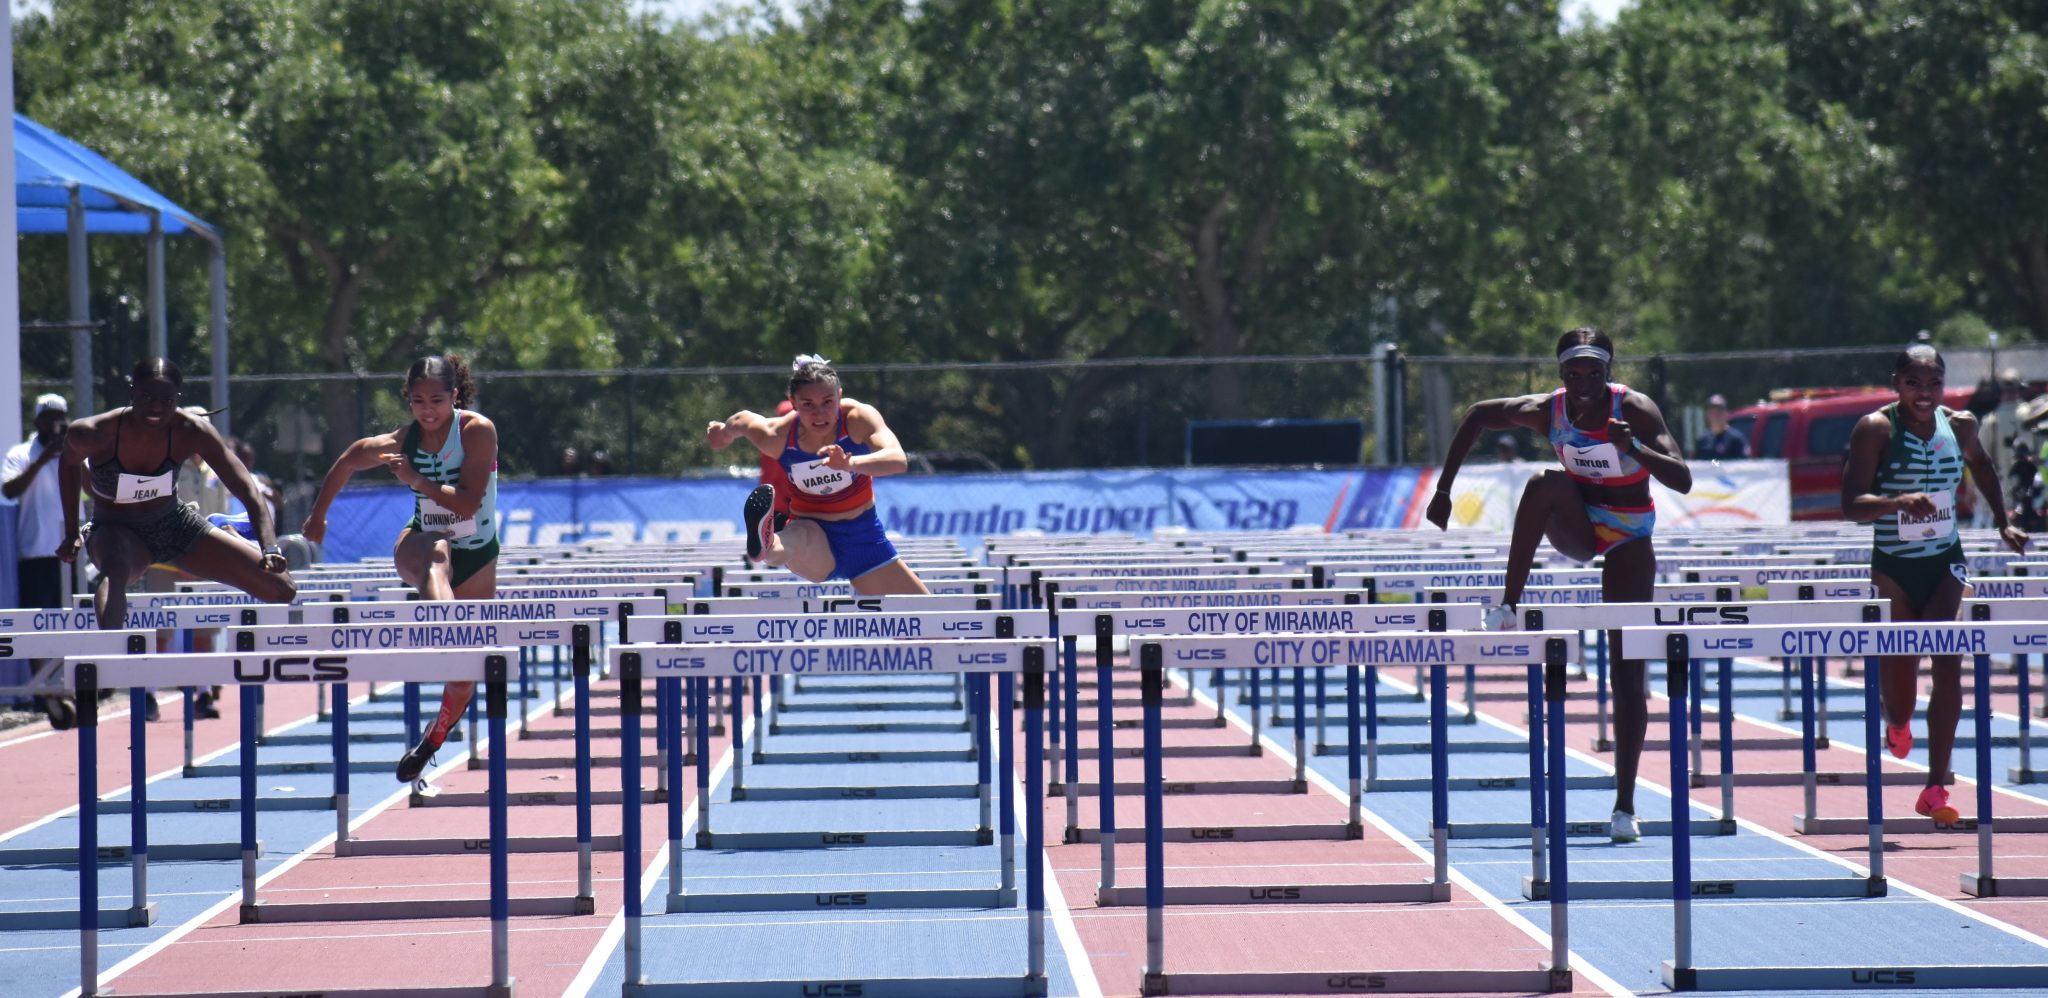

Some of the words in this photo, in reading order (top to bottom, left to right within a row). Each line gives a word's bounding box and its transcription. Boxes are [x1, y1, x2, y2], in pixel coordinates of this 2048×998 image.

[1573, 458, 1610, 468] TAYLOR
[802, 472, 843, 488] VARGAS
[132, 488, 159, 499] JEAN
[886, 504, 1024, 536] Mondo
[1035, 501, 1159, 534] Super
[1431, 575, 1462, 587] CITY
[1466, 575, 1484, 586] OF
[1488, 574, 1554, 586] MIMAR
[1569, 577, 1600, 585] UCS
[1814, 570, 1872, 580] MIRAMA
[1551, 590, 1572, 604] OF
[1670, 593, 1705, 601] UCS
[1825, 588, 1860, 597] UCS
[803, 599, 882, 612] UCS
[1141, 595, 1176, 608] CITY
[1181, 595, 1202, 608] OF
[1207, 594, 1281, 608] MIRAMAR
[360, 610, 395, 619] UCS
[414, 605, 450, 622] CITY
[455, 604, 475, 621] OF
[481, 603, 556, 620] MIRAMAR
[574, 607, 609, 616] UCS
[1655, 606, 1749, 625] UCS
[34, 612, 70, 631] CITY
[75, 612, 95, 630] OF
[123, 611, 177, 628] RAMAR
[196, 614, 230, 623] UCS
[1124, 618, 1166, 628] UCS
[1188, 612, 1229, 632] CITY
[1235, 612, 1259, 631] OF
[1265, 610, 1353, 631] MIRAMAR
[1375, 615, 1415, 624] UCS
[694, 625, 734, 635] UCS
[757, 619, 798, 640] CITY
[804, 618, 828, 639] OF
[834, 617, 921, 638] MIRAMAR
[942, 621, 983, 631] UCS
[267, 635, 308, 645] UCS
[332, 628, 373, 649] CITY
[379, 627, 403, 647] OF
[409, 625, 498, 647] MIRAMAR
[519, 630, 559, 640] UCS
[1704, 638, 1753, 649] UCS
[1782, 630, 1832, 655] CITY
[1839, 630, 1869, 654] OF
[1876, 628, 1986, 653] MIRAMAR
[2014, 634, 2048, 646] UC
[1177, 649, 1226, 660] UCS
[1254, 640, 1304, 665] CITY
[1311, 640, 1340, 664] OF
[1348, 638, 1455, 663] MIRAMAR
[1480, 645, 1529, 656] UCS
[656, 658, 705, 669] UCS
[733, 649, 783, 673] CITY
[790, 648, 819, 672] OF
[827, 647, 933, 672] MIRAMAR
[958, 653, 1007, 664] UCS
[234, 656, 349, 682] UCS
[1816, 774, 1840, 783] CS
[841, 789, 877, 798] UCS
[193, 799, 230, 809] UCS
[822, 834, 865, 844] UCS
[1191, 829, 1234, 839] UCS
[463, 839, 490, 850] UC
[98, 847, 125, 858] CS
[816, 894, 867, 906] UCS
[1250, 888, 1300, 900] UCS
[1327, 975, 1387, 989] UCS
[1852, 970, 1915, 984] UCS
[803, 984, 863, 997] UCS
